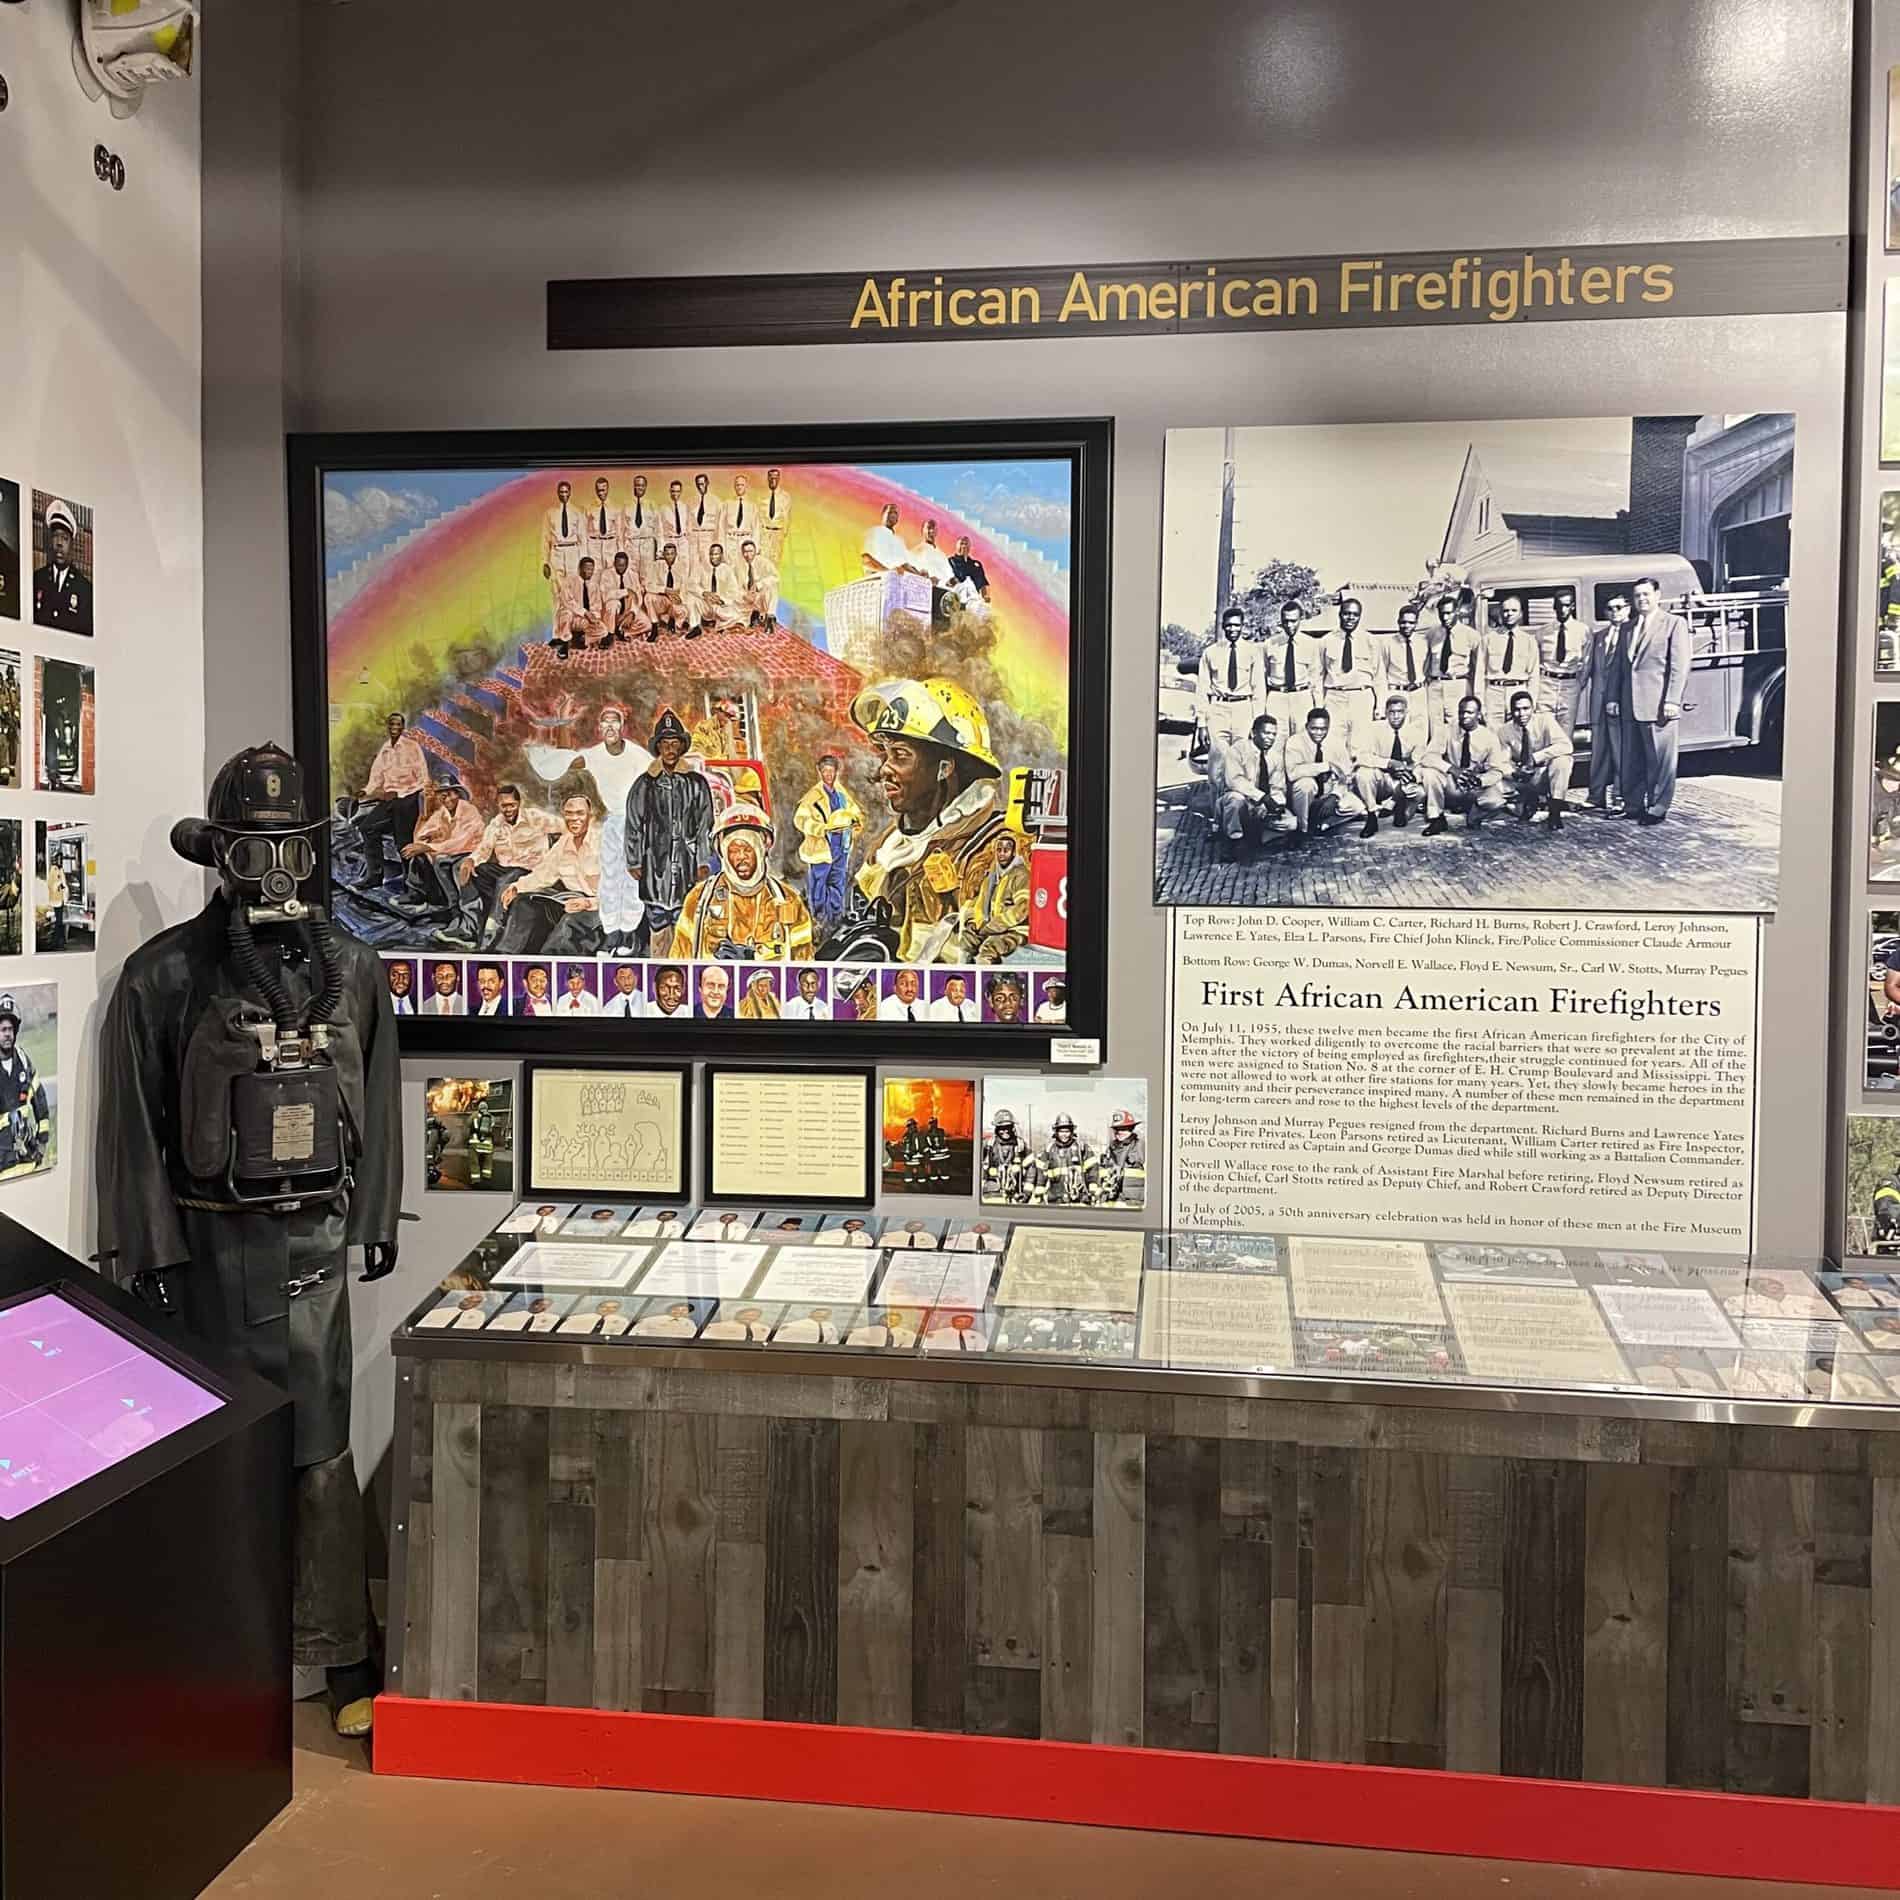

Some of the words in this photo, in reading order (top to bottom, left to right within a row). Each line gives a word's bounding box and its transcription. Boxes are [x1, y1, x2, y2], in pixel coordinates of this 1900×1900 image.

[850, 275, 1041, 329] African
[1056, 266, 1318, 323] American
[1339, 255, 1675, 321] Firefighters
[881, 709, 900, 729] 23
[266, 774, 281, 798] 8
[1182, 913, 1205, 927] Top
[1207, 913, 1235, 925] Row:
[1238, 914, 1265, 926] John
[1265, 914, 1279, 925] D.
[1327, 915, 1370, 927] William
[1372, 916, 1386, 927] C.
[1429, 917, 1473, 928] Richard
[1475, 917, 1492, 929] H.
[1532, 918, 1571, 930] Robert
[1573, 919, 1582, 931] J.
[1643, 920, 1676, 935] Leroy
[1183, 929, 1233, 940] Lawrence
[1369, 932, 1391, 943] Fire
[1393, 932, 1423, 944] Chief
[1426, 933, 1452, 945] John
[1497, 934, 1557, 946] Fire/Police
[1559, 935, 1640, 947] Commissioner
[1641, 936, 1683, 948] Claude
[1685, 937, 1732, 949] Armour
[1182, 954, 1220, 966] Bottom
[1223, 955, 1250, 966] Row:
[1252, 956, 1290, 970] George
[1293, 956, 1309, 968] W.
[1354, 958, 1394, 969] Norvell
[1459, 959, 1489, 974] Floyd
[1580, 962, 1605, 973] Carl
[1608, 962, 1625, 973] W.
[1665, 963, 1707, 978] Murray
[1709, 964, 1748, 979] Pegues
[1200, 979, 1265, 1006] First
[1274, 981, 1382, 1009] African
[1393, 983, 1539, 1012] American
[1548, 986, 1721, 1022] Firefighters
[1180, 1021, 1199, 1032] On
[1203, 1021, 1224, 1035] July
[1284, 1023, 1315, 1035] these
[1317, 1024, 1354, 1036] twelve
[1357, 1028, 1382, 1036] men
[1385, 1025, 1429, 1037] became
[1432, 1027, 1451, 1038] the
[1454, 1027, 1477, 1039] first
[1481, 1028, 1526, 1040] African
[1529, 1029, 1588, 1041] American
[1591, 1030, 1656, 1046] firefighters
[1659, 1032, 1678, 1043] for
[1680, 1032, 1700, 1044] the
[1703, 1033, 1730, 1048] City
[1732, 1033, 1745, 1045] of
[1180, 1032, 1235, 1047] Memphis.
[1237, 1034, 1267, 1048] They
[1269, 1035, 1311, 1046] worked
[1313, 1036, 1367, 1051] diligently
[1369, 1037, 1381, 1048] to
[1383, 1040, 1439, 1050] overcome
[1442, 1039, 1461, 1050] the
[1464, 1039, 1498, 1051] racial
[1498, 1040, 1544, 1052] barriers
[1546, 1041, 1570, 1053] that
[1573, 1045, 1601, 1054] were
[1604, 1046, 1618, 1054] so
[1620, 1043, 1676, 1059] prevalent
[1678, 1044, 1691, 1056] at
[1693, 1045, 1713, 1056] the
[1716, 1045, 1747, 1057] time.
[1177, 1136, 1205, 1149] John
[1207, 1137, 1247, 1152] Cooper
[1249, 1138, 1286, 1150] retired
[1288, 1142, 1300, 1151] as
[1302, 1140, 1345, 1155] Captain
[1347, 1141, 1369, 1153] and
[1371, 1142, 1412, 1157] George
[1414, 1144, 1454, 1156] Dumas
[1456, 1145, 1481, 1157] died
[1483, 1146, 1514, 1158] while
[1516, 1147, 1537, 1158] still
[1539, 1148, 1586, 1163] working
[1588, 1152, 1601, 1161] as
[1613, 1150, 1666, 1163] Battalion
[1668, 1152, 1745, 1165] Commander.
[1178, 1180, 1190, 1191] of
[1192, 1181, 1210, 1192] the
[1212, 1182, 1277, 1198] department.
[1179, 1169, 1225, 1181] Division
[1264, 1172, 1288, 1183] Carl
[1291, 1173, 1324, 1185] Stotts
[1326, 1174, 1364, 1186] retired
[1366, 1179, 1381, 1187] as
[1381, 1176, 1423, 1191] Deputy
[1464, 1179, 1486, 1190] and
[1489, 1180, 1528, 1192] Robert
[1531, 1181, 1586, 1194] Crawford
[1588, 1183, 1628, 1195] retired
[1630, 1188, 1643, 1196] as
[1646, 1185, 1690, 1201] Deputy
[1692, 1187, 1744, 1200] Director
[1178, 1202, 1191, 1213] In
[1192, 1202, 1216, 1217] July
[1218, 1203, 1230, 1214] of
[1278, 1206, 1304, 1217] 50th
[1306, 1207, 1371, 1223] anniversary
[1375, 1209, 1438, 1222] celebration
[1441, 1215, 1462, 1223] was
[1466, 1213, 1491, 1224] held
[1494, 1214, 1506, 1225] in
[1509, 1214, 1544, 1227] honor
[1547, 1216, 1559, 1227] of
[1562, 1216, 1593, 1228] these
[1596, 1221, 1622, 1230] men
[1625, 1219, 1636, 1230] at
[1640, 1219, 1659, 1231] the
[1663, 1220, 1687, 1232] Fire
[1690, 1221, 1742, 1234] Museum
[1178, 1213, 1189, 1224] of
[1192, 1214, 1245, 1230] Memphis.
